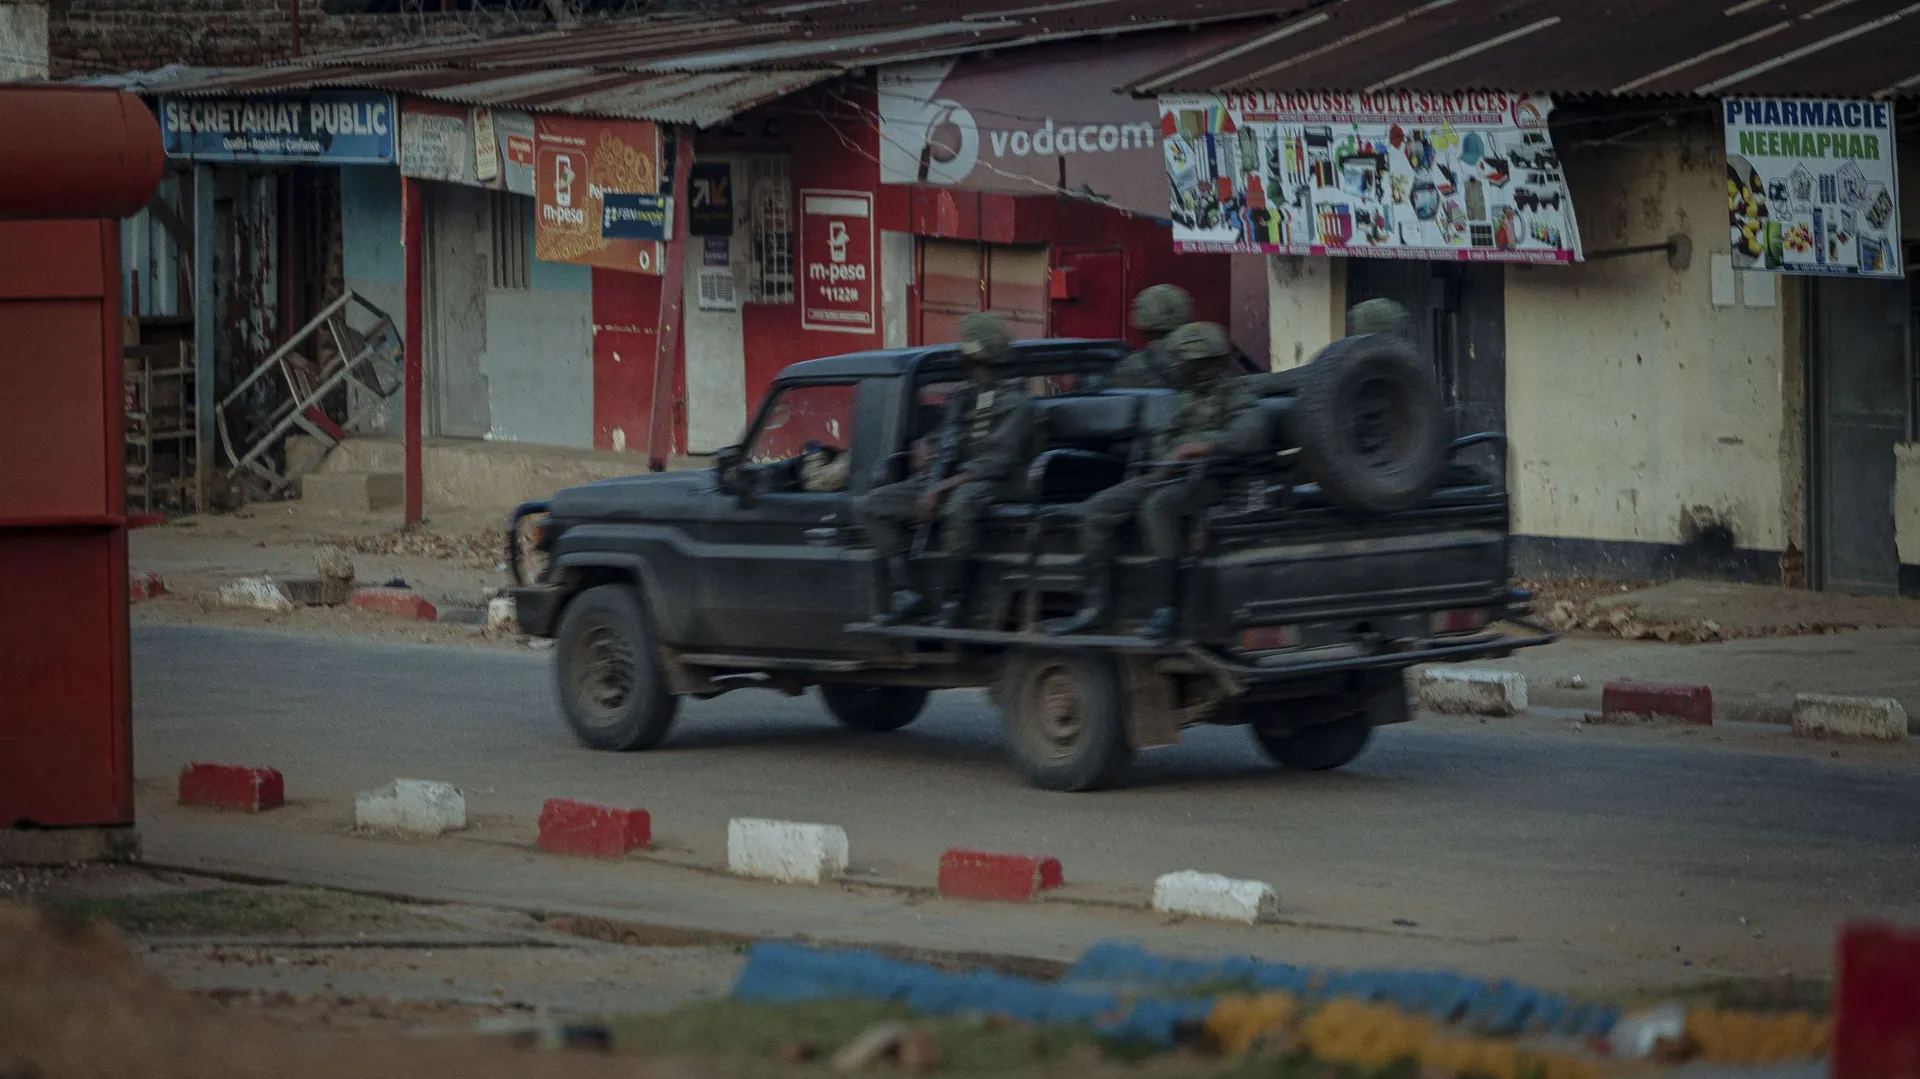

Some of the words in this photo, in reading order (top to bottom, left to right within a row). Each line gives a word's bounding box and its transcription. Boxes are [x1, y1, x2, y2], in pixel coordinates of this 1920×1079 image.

[1263, 90, 1353, 112] LAROUSSE
[1359, 89, 1507, 113] MULTI-SERVICES
[1727, 100, 1888, 129] PHARMACIE
[166, 103, 302, 134] SECRETARIAT
[310, 103, 388, 135] PUBLIC
[990, 116, 1154, 157] vodacom
[1738, 132, 1881, 161] NEEMAPHAR
[809, 262, 867, 285] m-pesa
